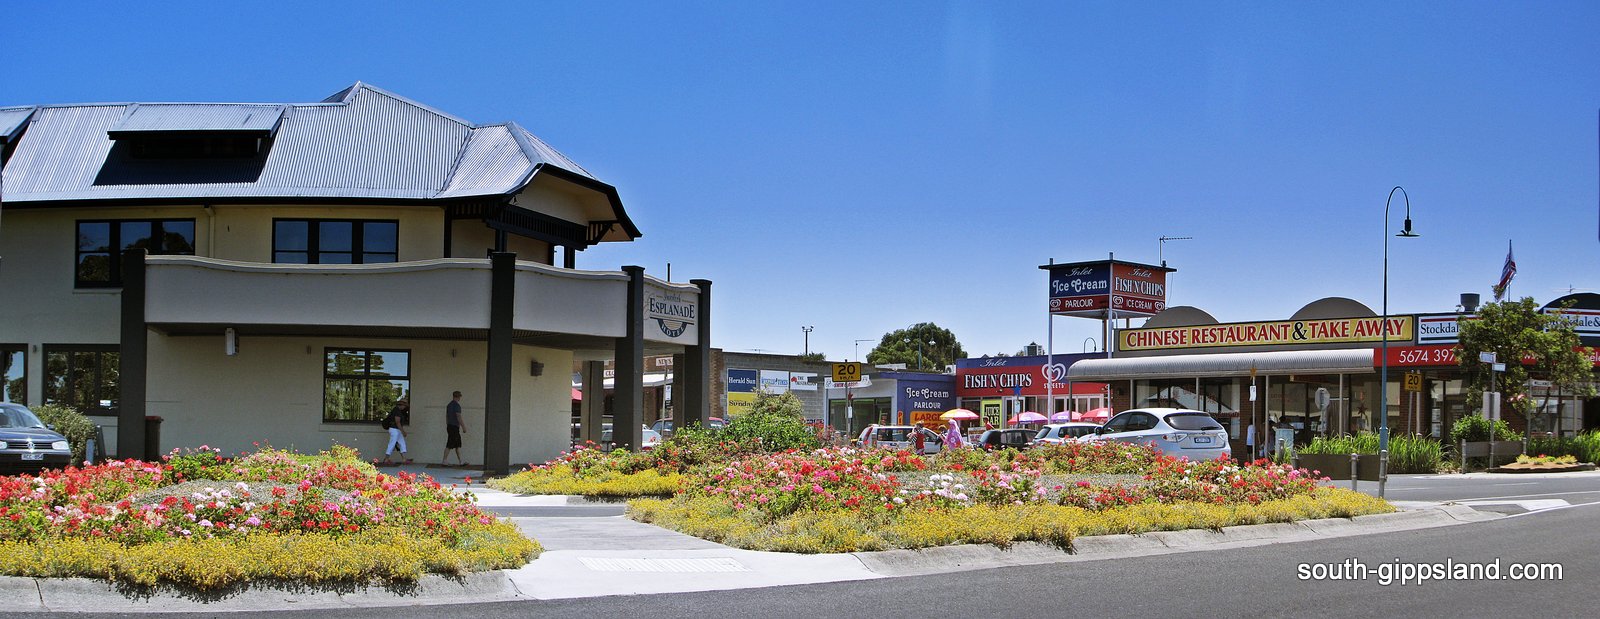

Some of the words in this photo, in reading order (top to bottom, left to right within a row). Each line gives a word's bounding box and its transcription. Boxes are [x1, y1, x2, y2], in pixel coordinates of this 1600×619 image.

[1065, 267, 1093, 277] Inlet
[1128, 267, 1152, 278] Inlet
[1052, 280, 1069, 294] Ice
[1070, 278, 1107, 293] Cream
[1115, 277, 1132, 293] FISH
[1141, 281, 1163, 297] CHIPS
[650, 297, 695, 319] ESPLANADE
[1065, 298, 1094, 308] PARLOUR
[1126, 299, 1135, 308] ICE
[1135, 300, 1153, 310] CREAM
[1126, 329, 1187, 347] CHINESE
[1191, 324, 1291, 344] RESTAURANT
[1292, 321, 1308, 341] &
[1308, 320, 1350, 339] TAKE
[1353, 319, 1405, 337] AWAY
[1420, 322, 1460, 335] Stockdal
[1398, 350, 1429, 363] 5674
[1433, 348, 1463, 362] 397
[980, 358, 1007, 368] Inlet
[838, 364, 855, 375] 20
[746, 377, 756, 385] Sun
[964, 374, 988, 388] FISH
[1000, 373, 1032, 388] CHIPS
[1408, 375, 1419, 386] 20
[906, 387, 920, 398] Ice
[921, 387, 949, 399] Cream
[914, 401, 941, 409] PARLOUR
[985, 406, 1000, 416] JUICE
